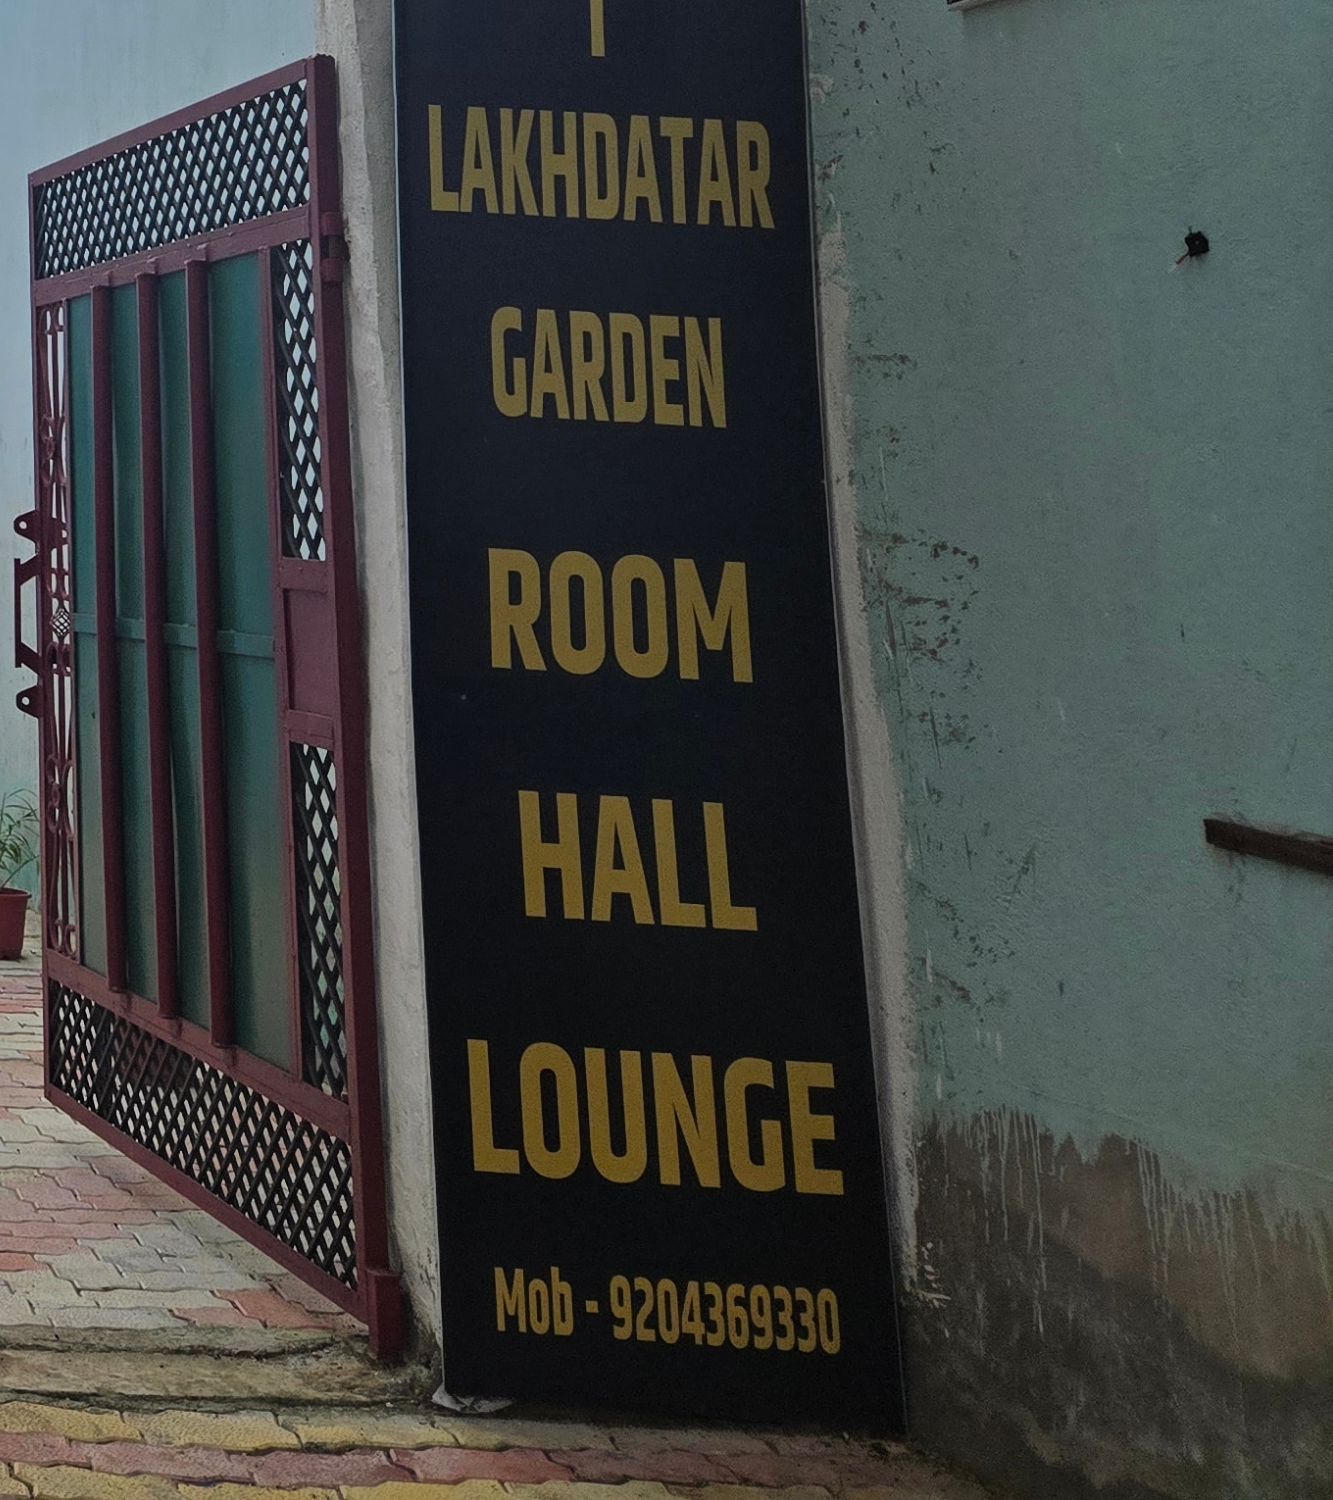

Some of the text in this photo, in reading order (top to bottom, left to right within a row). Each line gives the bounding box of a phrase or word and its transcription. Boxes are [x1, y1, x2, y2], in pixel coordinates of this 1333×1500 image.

[428, 104, 775, 229] LAKHDATAR
[490, 306, 727, 428] GARDEN
[488, 547, 753, 683] ROOM
[518, 790, 758, 931] HALL
[466, 1038, 845, 1195] LOUNGE
[494, 1266, 841, 1355] Mob - 9204369330
